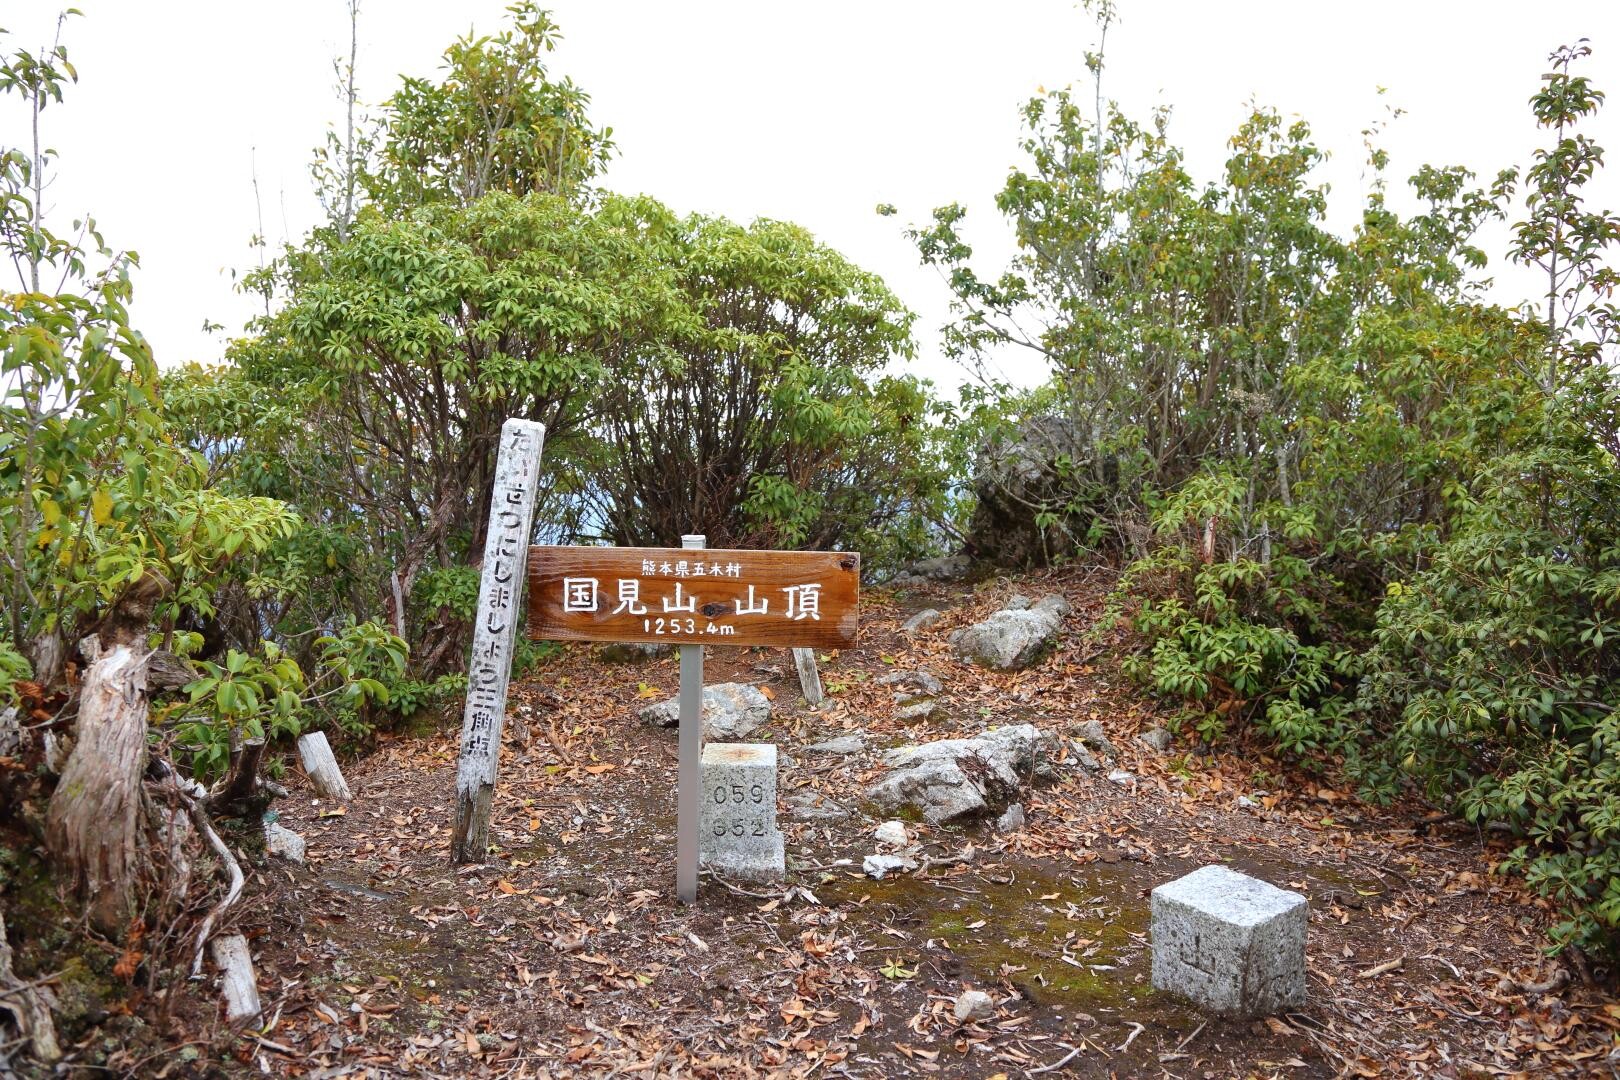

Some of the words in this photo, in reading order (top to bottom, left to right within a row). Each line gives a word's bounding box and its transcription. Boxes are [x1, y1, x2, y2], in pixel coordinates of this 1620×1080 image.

[641, 559, 741, 577] 熊本県五木村
[563, 577, 697, 615] 国見山
[735, 583, 822, 621] 山頂
[644, 618, 735, 635] 1253.4m
[713, 785, 763, 804] 059
